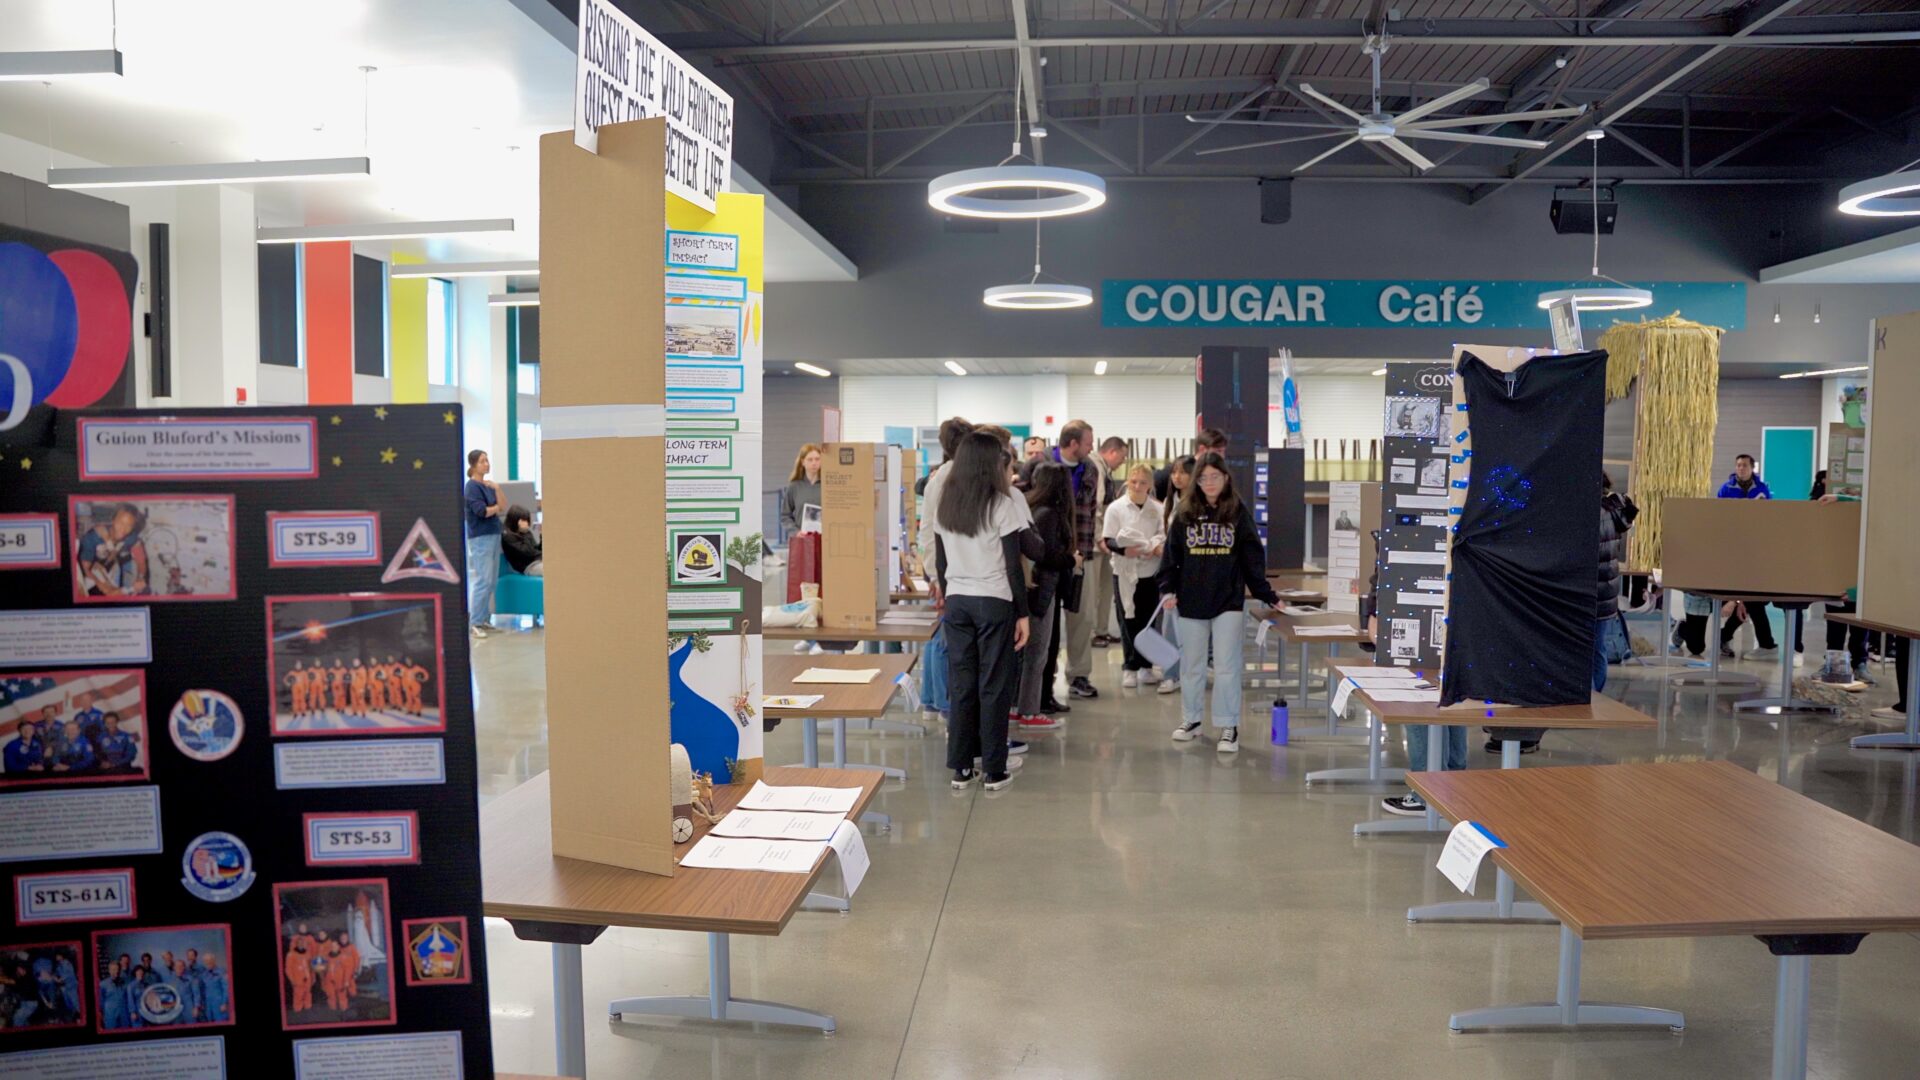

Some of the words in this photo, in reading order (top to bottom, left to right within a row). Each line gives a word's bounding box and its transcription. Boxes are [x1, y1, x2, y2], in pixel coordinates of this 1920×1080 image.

[584, 1, 630, 86] RISKING
[635, 38, 656, 102] THE
[661, 55, 684, 122] WILD
[688, 77, 731, 151] FRONTIER:
[673, 238, 705, 249] SHORT
[707, 239, 733, 251] TERM
[672, 253, 708, 264] IMPACT
[1125, 285, 1326, 323] COUGAR
[1378, 285, 1484, 323] Café
[96, 431, 147, 446] Guion
[153, 430, 229, 446] Bluford's
[234, 430, 302, 445] Missions
[666, 439, 696, 450] LONG
[698, 440, 728, 450] TERM
[666, 455, 709, 464] IMPACT
[293, 531, 357, 547] STS-39
[1186, 523, 1235, 548] SJHS
[329, 831, 392, 846] STS-53
[34, 887, 118, 906] STS-61A
